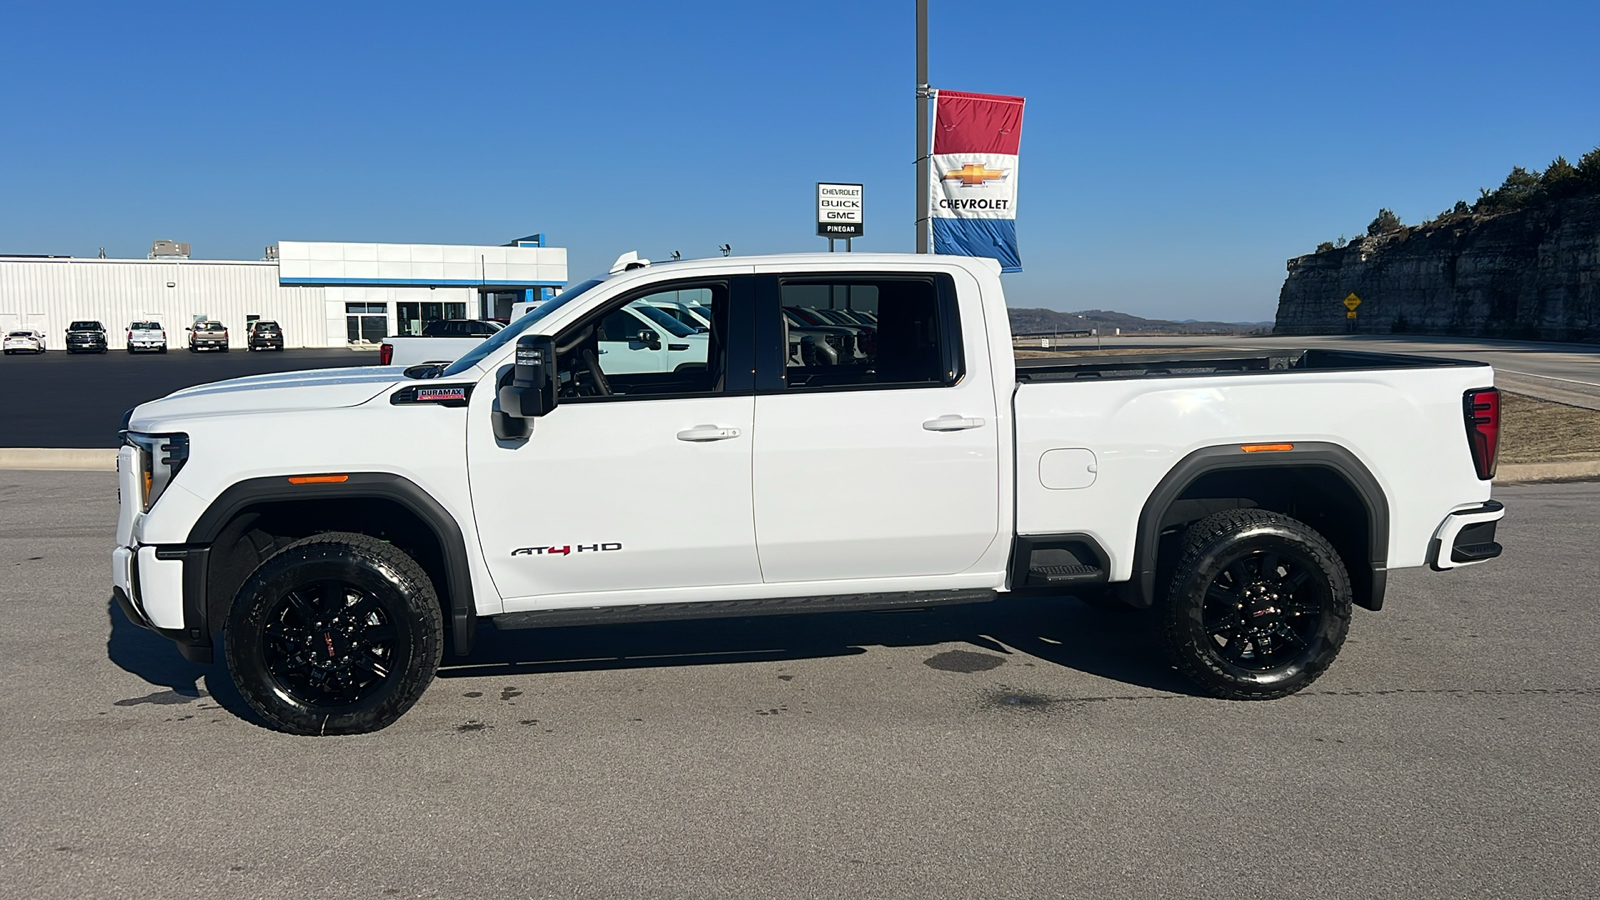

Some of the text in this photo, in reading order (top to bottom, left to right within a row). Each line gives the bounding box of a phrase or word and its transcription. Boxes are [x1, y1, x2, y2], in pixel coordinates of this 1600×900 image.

[822, 188, 859, 196] CHEVROLET
[821, 200, 860, 208] BUICK
[939, 199, 1008, 210] CHEVROLET
[826, 211, 856, 220] GMC
[826, 225, 856, 233] PINEGAR
[511, 543, 622, 557] AT4 HD
